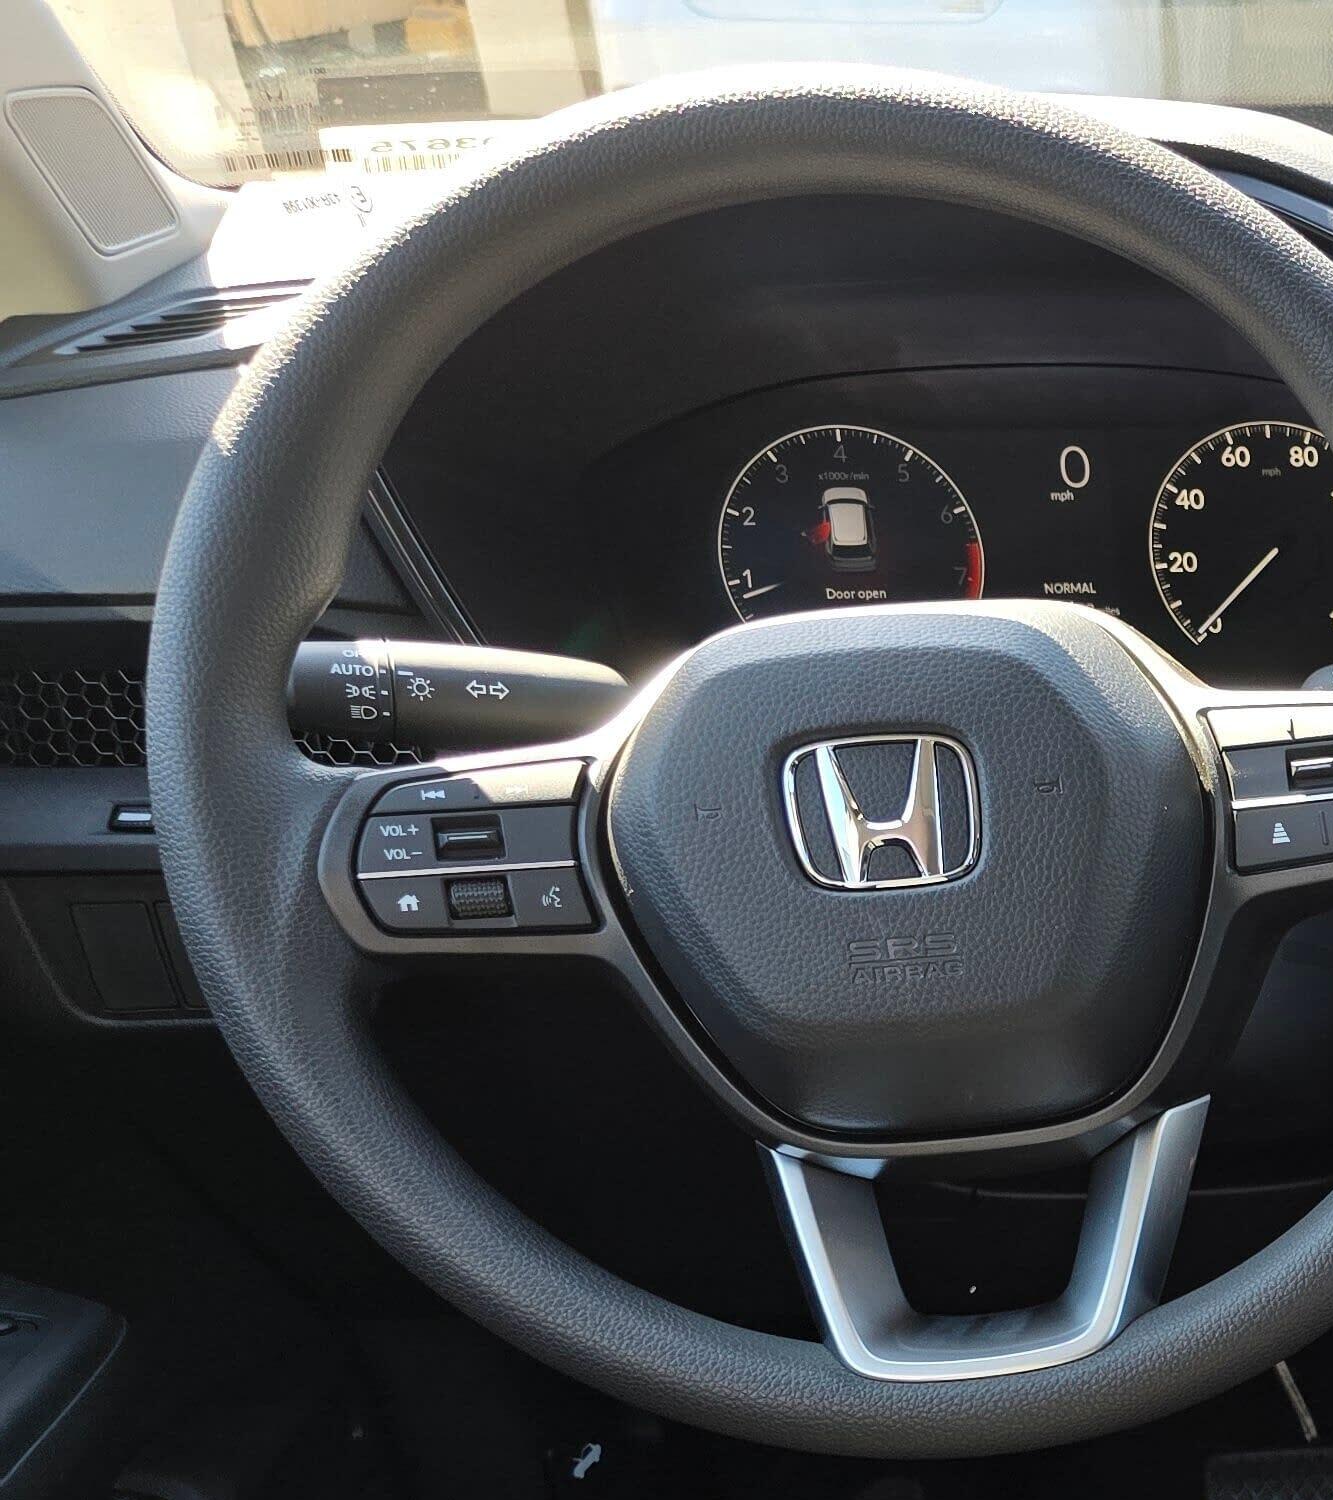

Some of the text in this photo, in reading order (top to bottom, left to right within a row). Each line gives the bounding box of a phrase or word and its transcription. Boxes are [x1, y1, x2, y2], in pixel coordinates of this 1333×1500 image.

[833, 444, 848, 462] 4
[1220, 446, 1251, 468] 60
[1288, 446, 1318, 468] 80
[775, 464, 789, 484] 3
[898, 464, 910, 482] 5
[1059, 444, 1091, 488] 0
[1262, 466, 1282, 478] mph
[1050, 490, 1075, 503] mph
[1174, 488, 1205, 510] 40
[742, 506, 756, 526] 2
[940, 506, 954, 524] 6
[1168, 551, 1198, 573] 20
[742, 569, 752, 588] 1
[954, 566, 967, 585] 7
[826, 587, 887, 601] Door open
[1043, 582, 1097, 595] NORMAL
[330, 663, 374, 677] AUTO
[847, 932, 957, 960] SRS
[852, 960, 964, 983] AIRBAG
